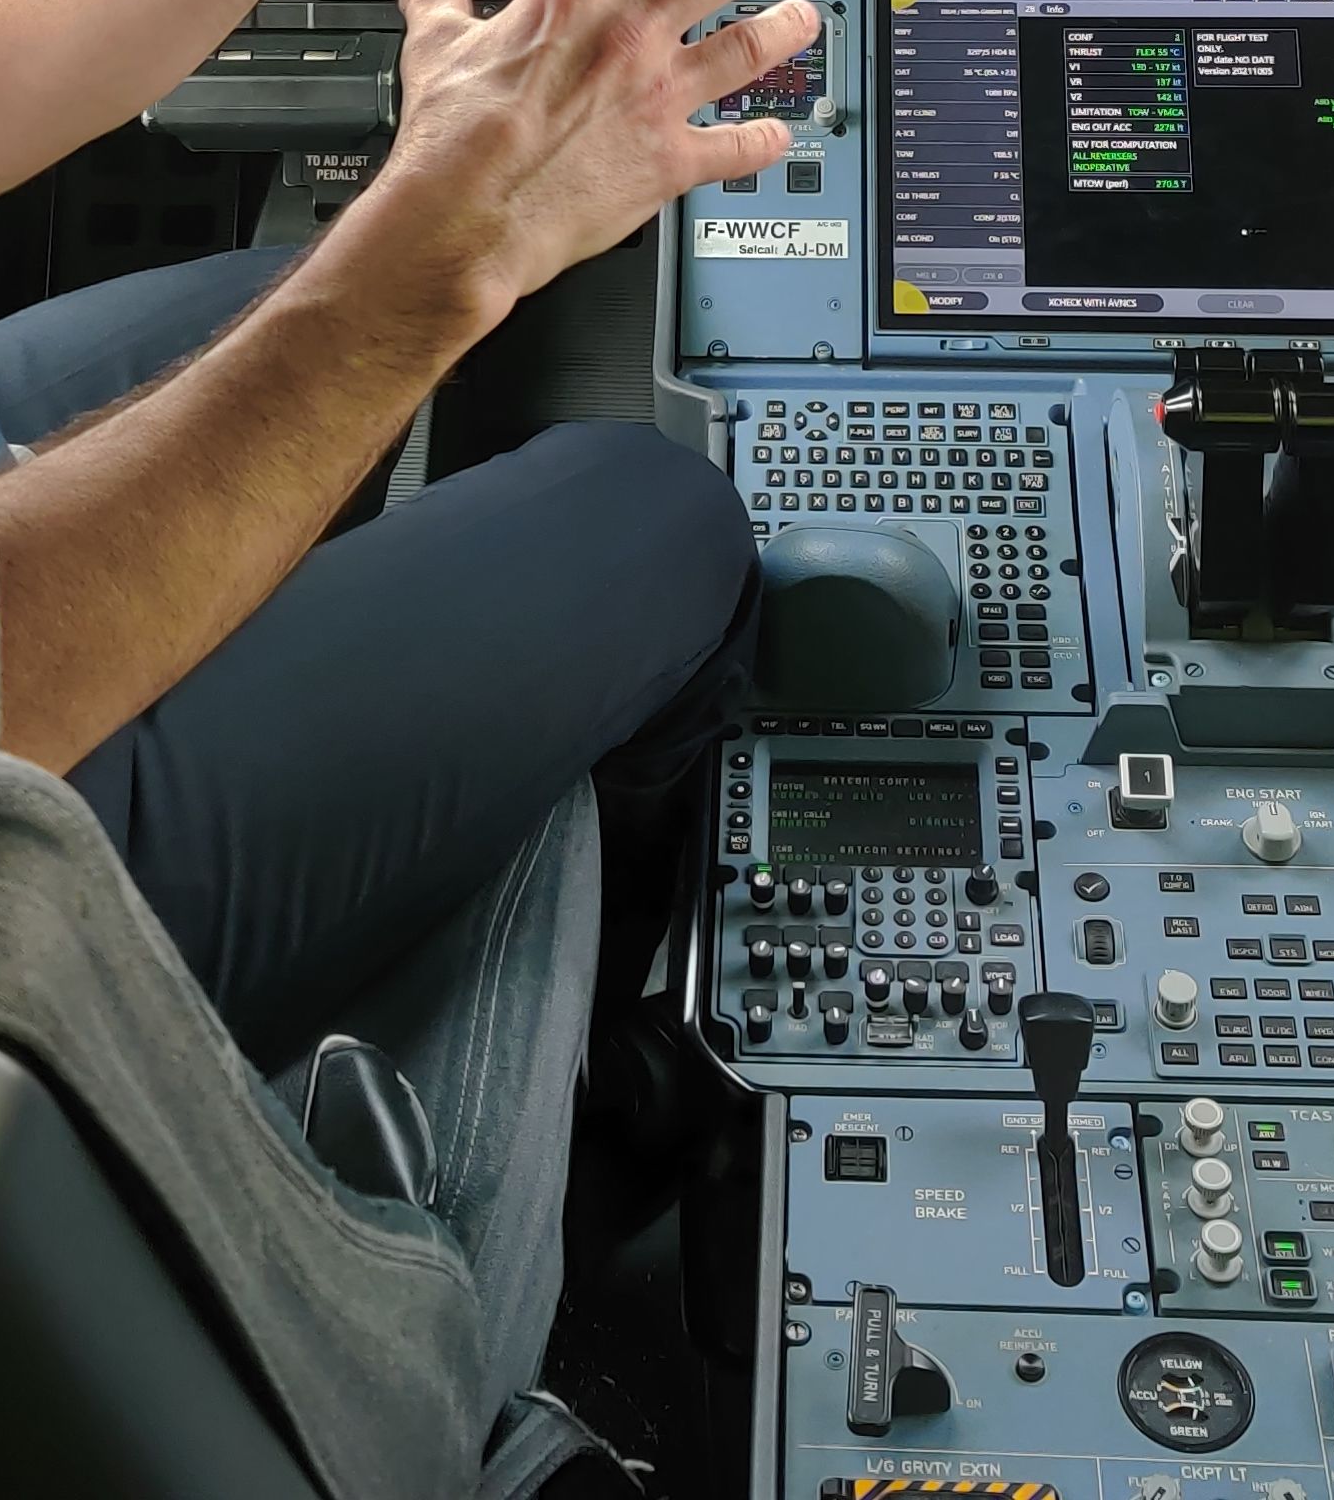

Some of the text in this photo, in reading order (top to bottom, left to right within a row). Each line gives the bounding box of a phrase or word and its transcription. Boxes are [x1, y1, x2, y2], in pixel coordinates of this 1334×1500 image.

[1068, 33, 1094, 41] CONF
[1197, 33, 1269, 42] FOR FLIGHT TEST
[1198, 67, 1273, 75] Version 20211005
[1071, 108, 1184, 116] LIMITATION TOW VMCA
[1072, 123, 1132, 131] ENG OUT ACC
[1072, 141, 1177, 149] REV FOR COMPUTATION
[306, 155, 320, 166] TO
[1073, 163, 1130, 171] INOPERATIVE
[317, 169, 358, 181] PEDALS
[1073, 179, 1103, 188] MTOW
[1106, 179, 1128, 189] (perf)
[703, 222, 801, 239] F-WWCF
[739, 243, 843, 257] Selcal: AJ-DM
[929, 297, 963, 305] MODIFY
[1048, 298, 1137, 308] XCHECK WITH AVNCS
[1225, 788, 1302, 800] ENG START
[1200, 818, 1233, 828] CRANK
[1303, 819, 1333, 829] START
[1171, 1048, 1189, 1057] ALL
[1290, 1110, 1333, 1121] TCAS
[834, 1122, 880, 1132] DESCENT
[914, 1189, 965, 1202] SPEED
[915, 1206, 967, 1220] BRAKE
[1003, 1266, 1029, 1275] FULL
[1103, 1269, 1130, 1279] FULL
[999, 1340, 1057, 1352] REINFLATE
[1161, 1358, 1203, 1370] YELLOW
[1128, 1390, 1158, 1401] ACCU
[1169, 1426, 1208, 1437] GREEN
[867, 1459, 1001, 1477] L/G GRVTY EXTN
[1180, 1465, 1247, 1481] CKPT LT
